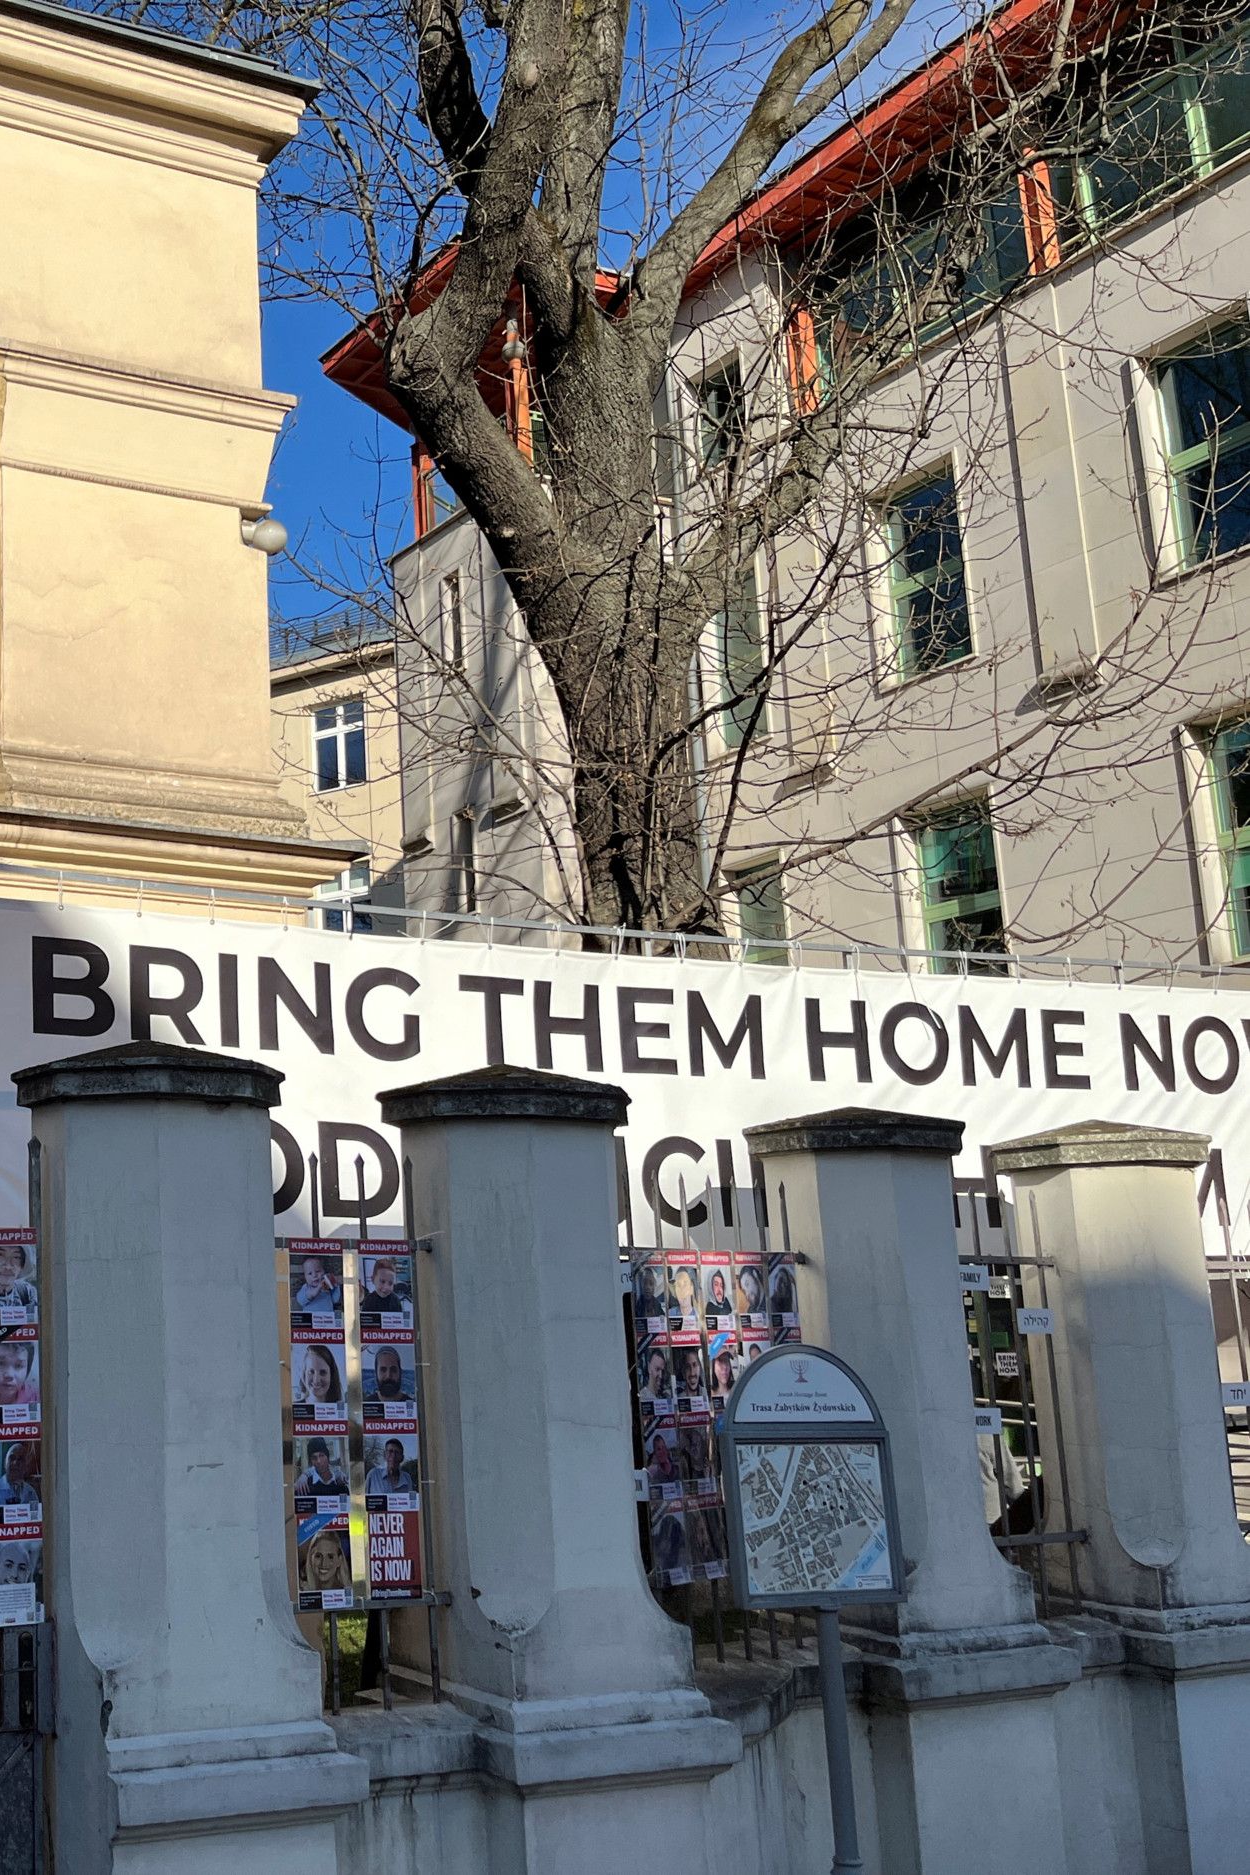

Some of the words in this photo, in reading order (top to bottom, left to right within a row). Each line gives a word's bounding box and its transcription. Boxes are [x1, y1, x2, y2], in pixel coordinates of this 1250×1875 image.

[30, 935, 420, 1062] BRING
[458, 974, 766, 1081] THEM
[805, 997, 1092, 1090] HOME
[1120, 1012, 1250, 1095] NO
[291, 1241, 341, 1250] KIDNAPPED
[360, 1243, 408, 1252] KIDNAPPED
[1024, 1316, 1049, 1328] קהילה
[293, 1332, 343, 1340] KIDNAPPED
[363, 1332, 412, 1340] KIDNAPPED
[1230, 1389, 1246, 1400] יחד
[751, 1403, 772, 1412] Trasa
[774, 1402, 810, 1414] Zabytków
[813, 1401, 856, 1414] Żydowskich
[295, 1424, 346, 1432] KIDNAPPED
[366, 1422, 414, 1430] KIDNAPPED
[369, 1513, 405, 1535] NEVER
[370, 1537, 405, 1558] AGAIN
[371, 1560, 382, 1582] IS
[384, 1560, 411, 1581] NOW
